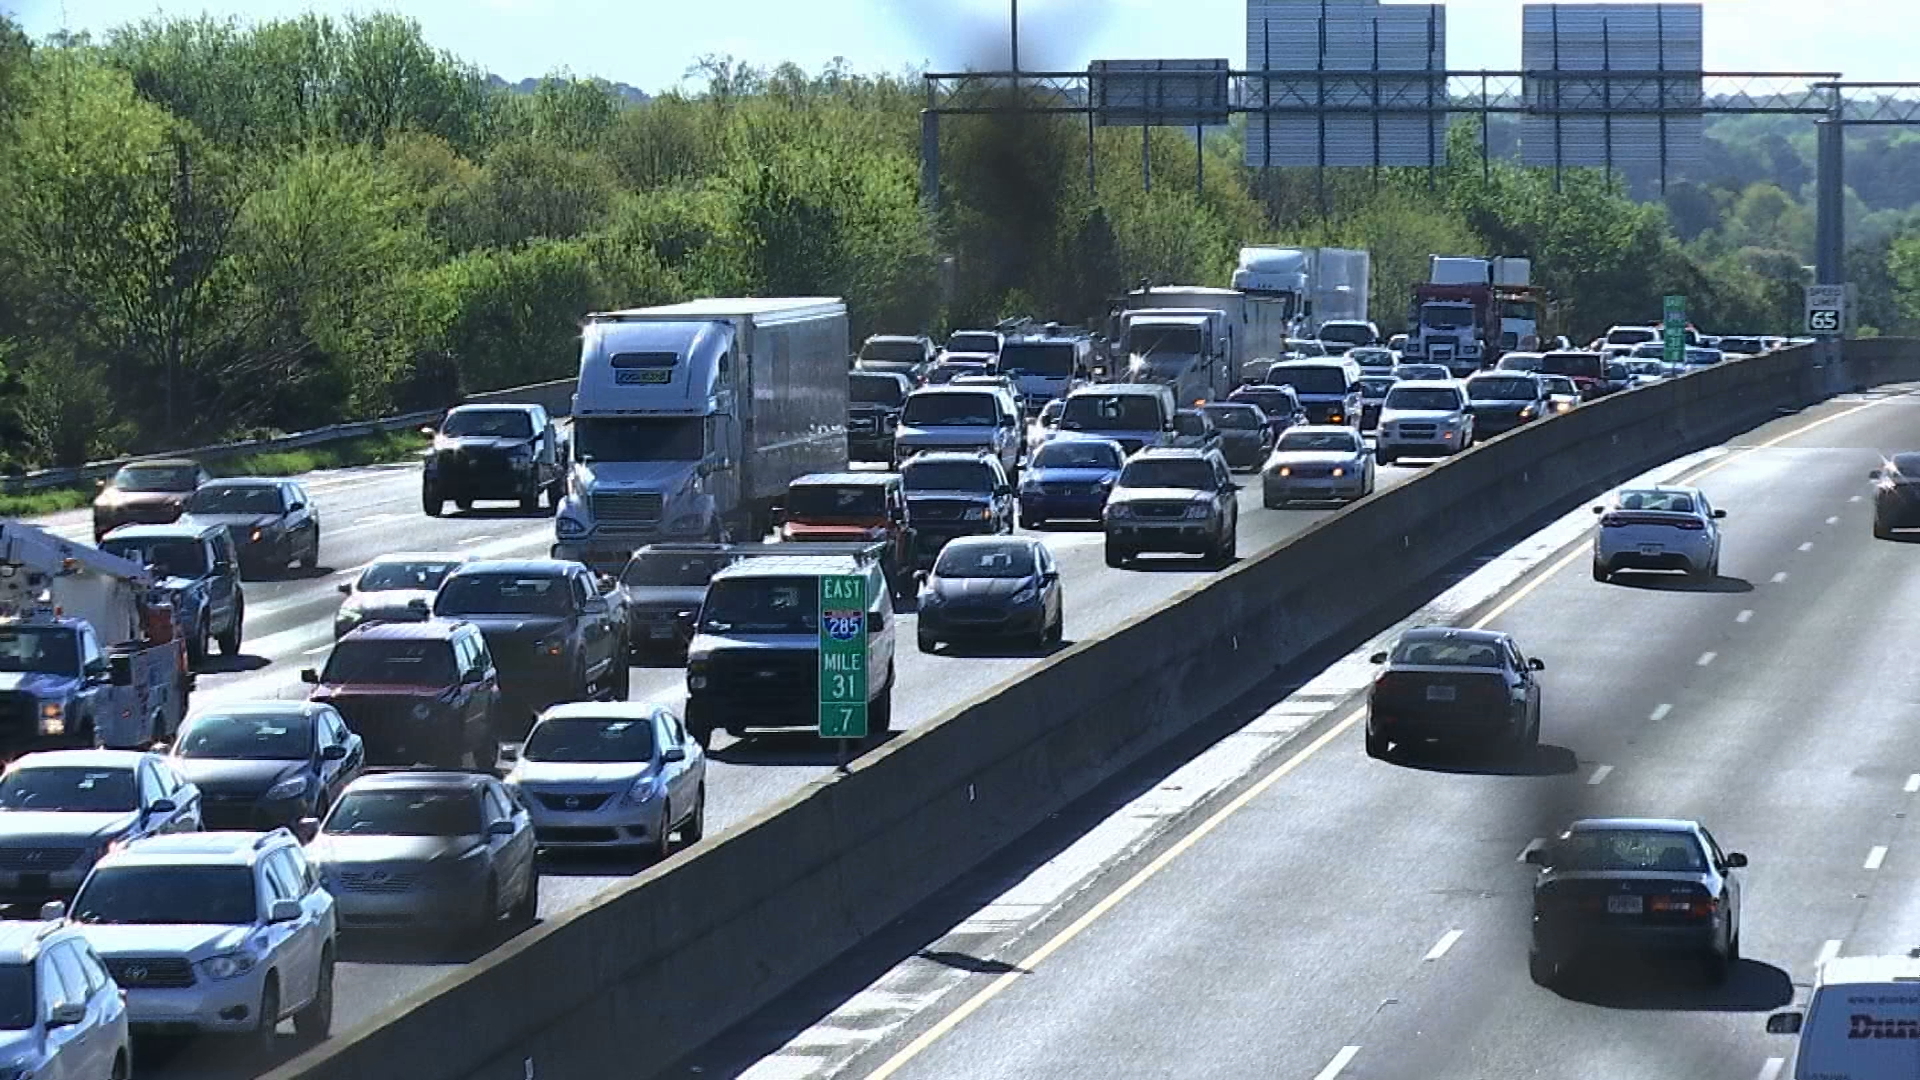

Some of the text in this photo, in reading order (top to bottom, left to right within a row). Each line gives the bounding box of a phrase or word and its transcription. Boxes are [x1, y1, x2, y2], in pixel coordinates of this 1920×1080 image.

[1811, 311, 1837, 329] 65
[824, 579, 861, 599] EAST
[829, 618, 859, 635] 285
[824, 653, 861, 671] MILE
[832, 674, 854, 699] 31
[833, 709, 853, 732] .7
